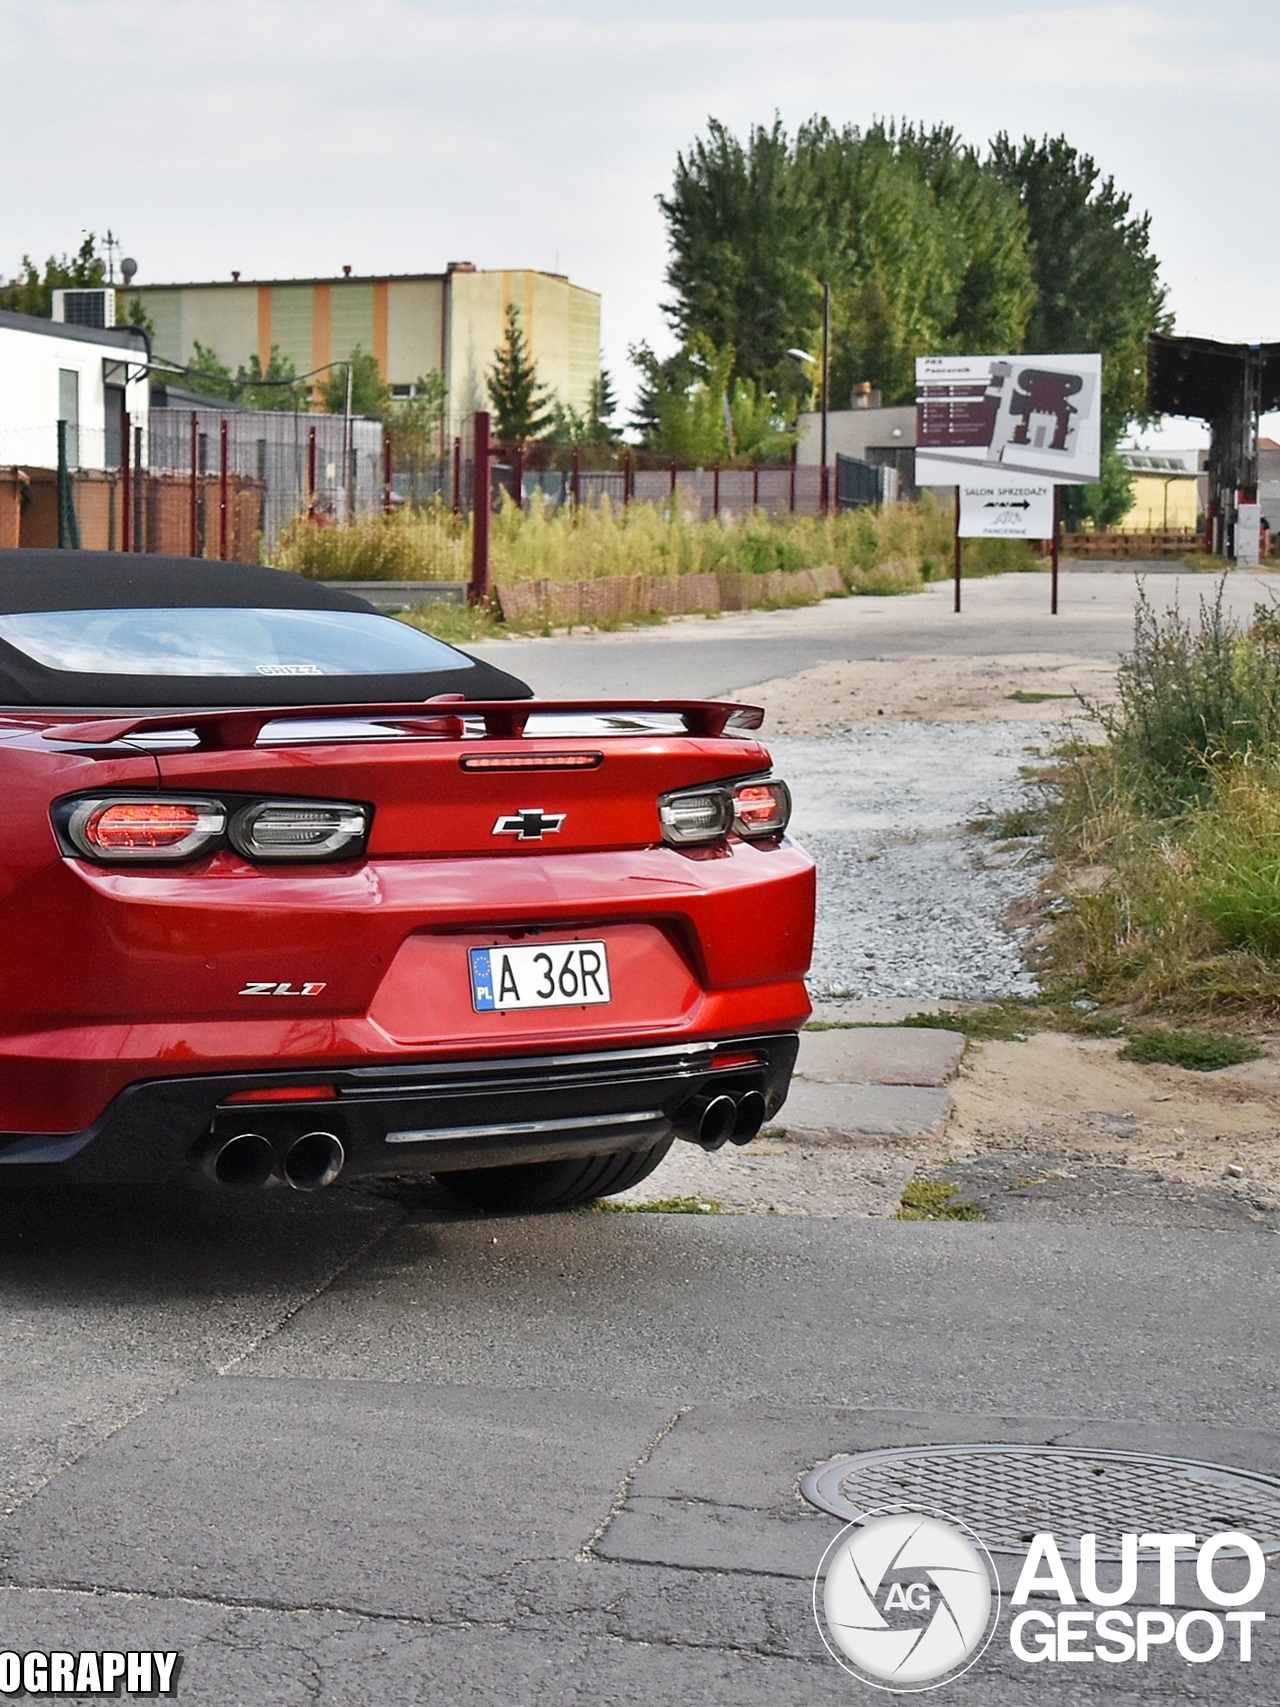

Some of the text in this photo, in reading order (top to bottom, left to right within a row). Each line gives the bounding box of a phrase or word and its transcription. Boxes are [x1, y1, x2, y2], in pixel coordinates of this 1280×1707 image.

[964, 487, 1047, 496] SALON SPRZEDAŻY
[257, 665, 321, 675] GRIZZ
[499, 949, 604, 1002] A 36R
[238, 982, 327, 996] ZL1
[476, 986, 493, 1000] PL
